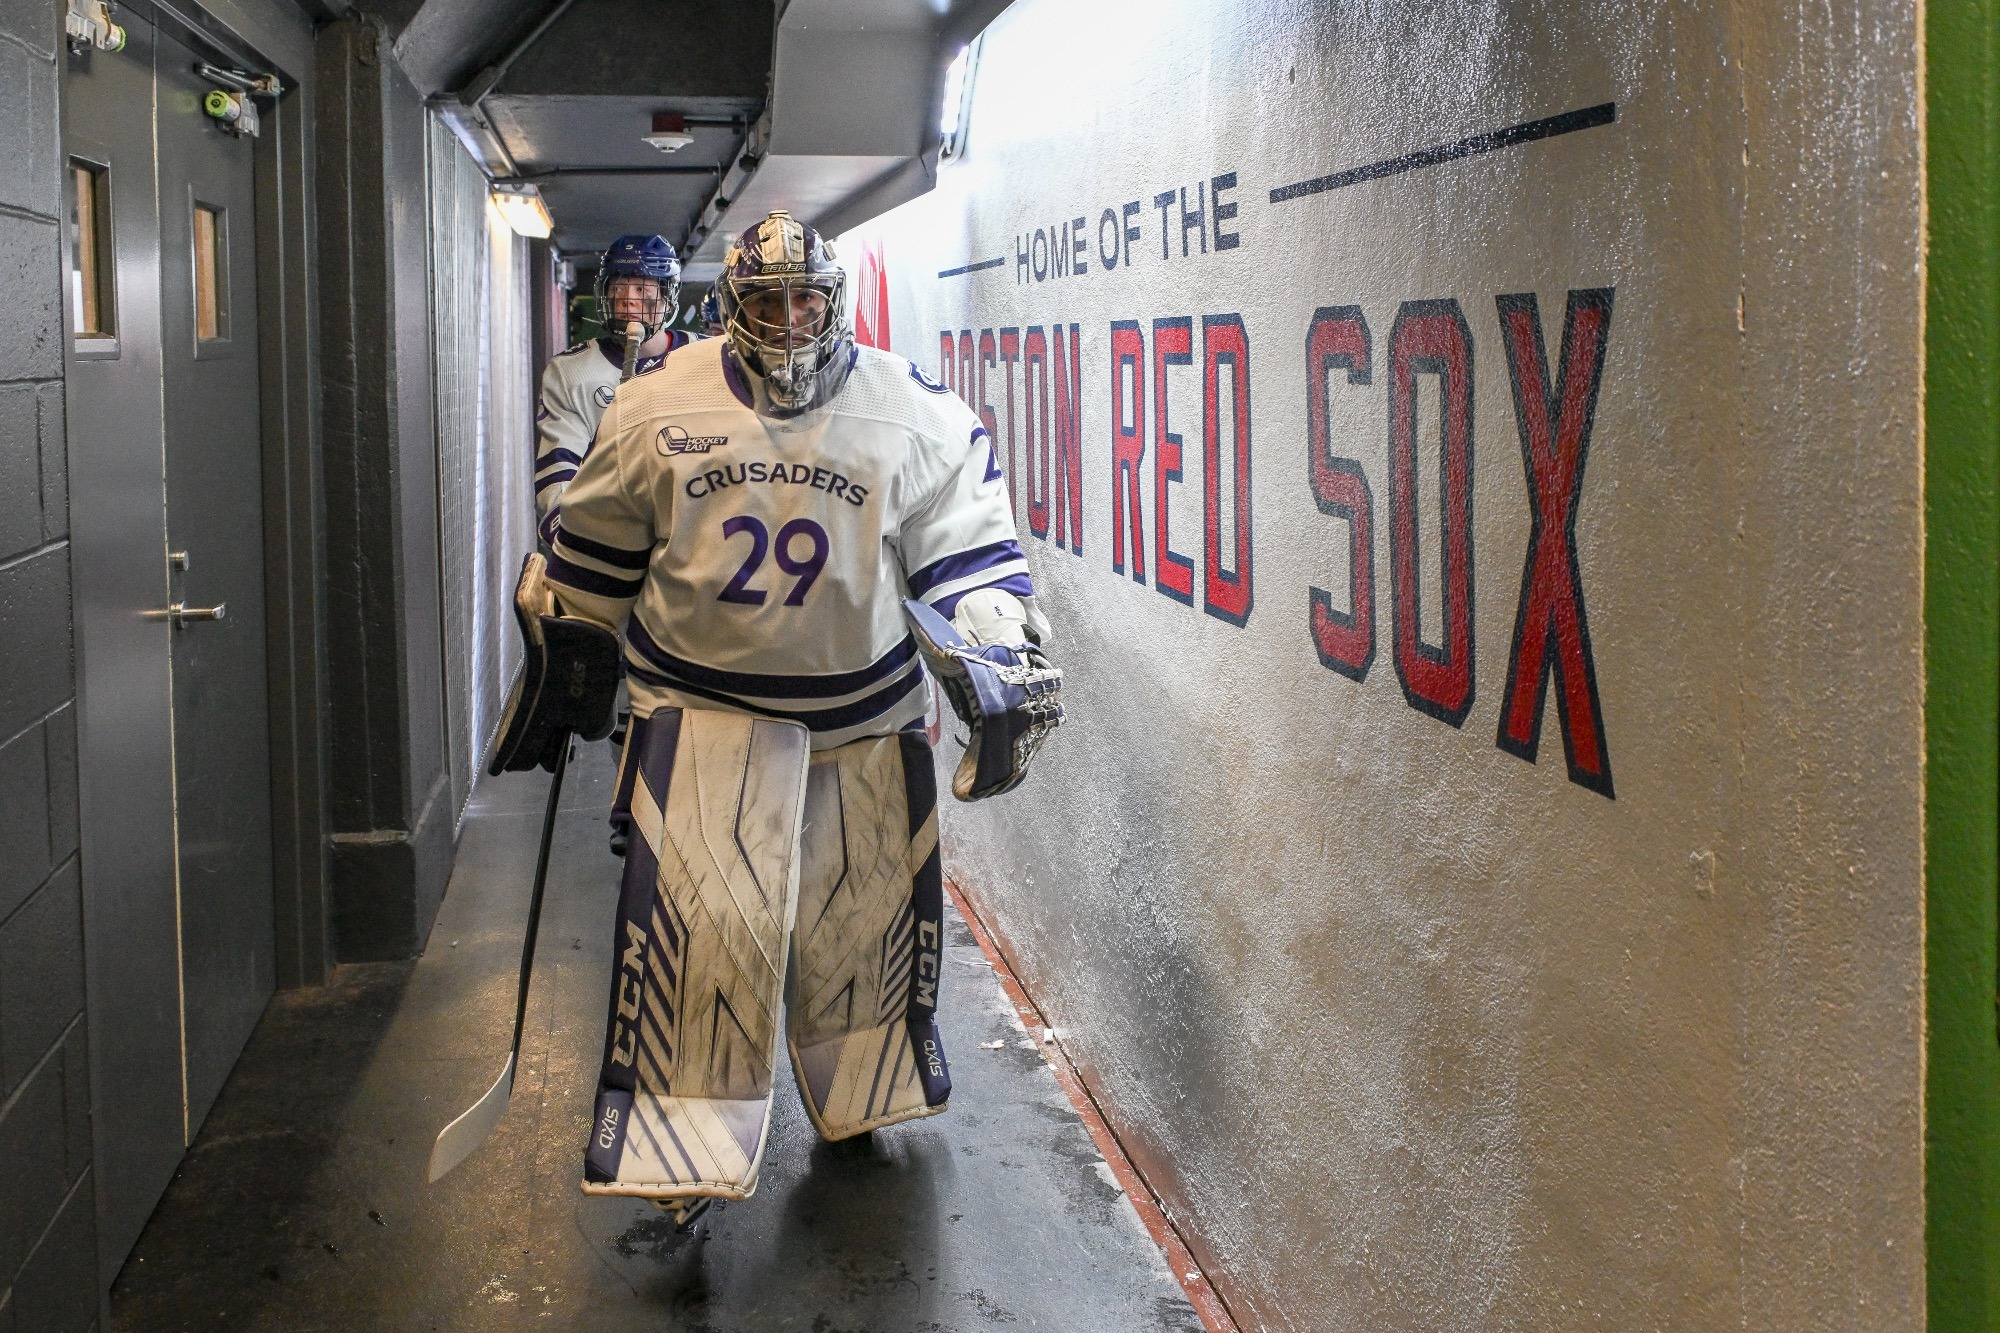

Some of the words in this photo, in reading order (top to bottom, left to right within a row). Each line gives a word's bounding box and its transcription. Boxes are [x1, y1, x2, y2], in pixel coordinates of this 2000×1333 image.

[761, 263, 807, 273] BAUER
[1016, 215, 1088, 284] HOME
[1099, 201, 1141, 270] OF
[1154, 171, 1240, 260] THE
[685, 444, 708, 452] EAST
[686, 437, 725, 445] HOCKEY
[686, 462, 869, 507] CRUSADERS
[717, 515, 830, 607] 29
[1110, 312, 1254, 629] RED
[1306, 286, 1616, 801] SOX
[611, 920, 648, 1069] CCM
[916, 919, 938, 1008] CCM
